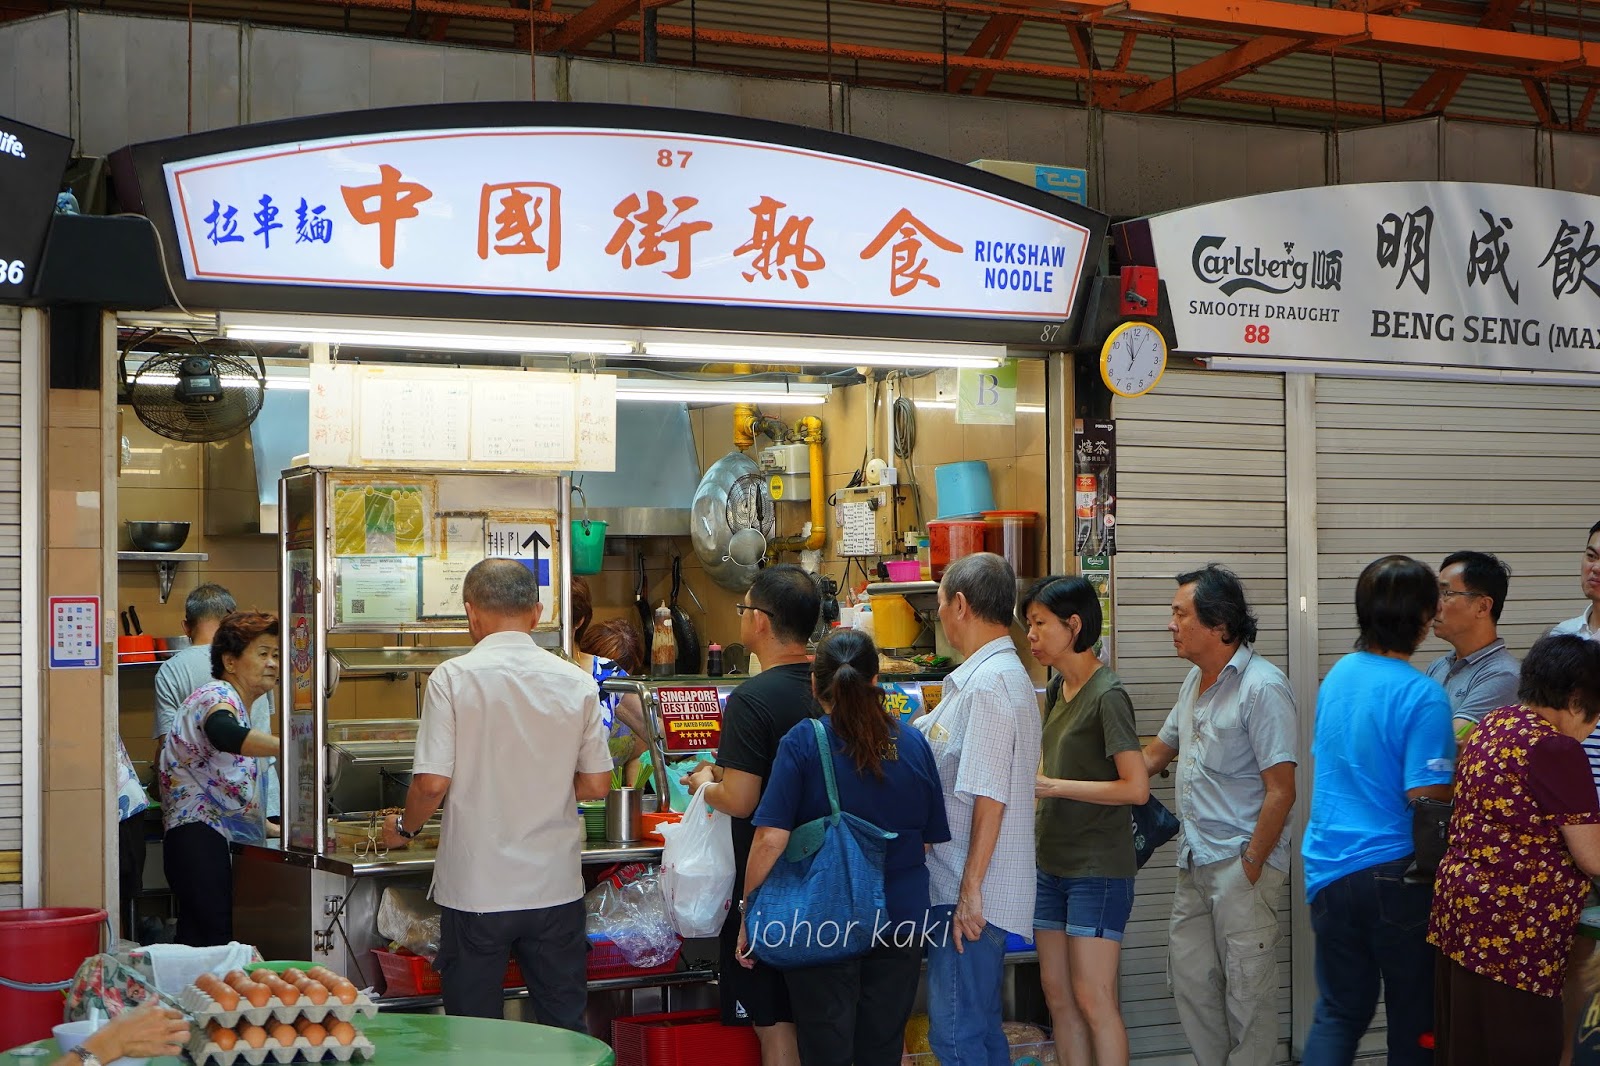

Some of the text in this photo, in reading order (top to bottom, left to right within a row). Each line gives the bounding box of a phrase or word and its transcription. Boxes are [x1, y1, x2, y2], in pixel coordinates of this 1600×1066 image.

[656, 150, 693, 168] 87
[203, 194, 333, 249] 拉車麵
[975, 240, 1066, 268] RICKSHAW
[1191, 235, 1309, 292] Carlsberg
[985, 267, 1053, 293] NOODLE
[1189, 300, 1340, 323] SMOOTH DRAUGHT
[1040, 324, 1061, 342] 87
[1133, 328, 1142, 337] 12
[1370, 309, 1454, 342] BENG
[1463, 315, 1540, 347] SENG
[1122, 332, 1129, 340] 11
[1146, 333, 1150, 341] 1
[1244, 324, 1270, 344] 88
[1112, 341, 1120, 350] 10
[1152, 343, 1158, 352] 2
[1106, 354, 1112, 363] 9
[1153, 356, 1159, 365] 3
[1108, 368, 1114, 377] 8
[1148, 370, 1153, 378] 4
[1116, 378, 1122, 387] 7
[1126, 382, 1132, 391] 6
[1138, 379, 1144, 388] 5
[976, 374, 999, 406] B
[1078, 439, 1110, 455] 焙茶
[660, 690, 717, 702] SINGAPORE
[663, 702, 717, 713] BEST FOODS
